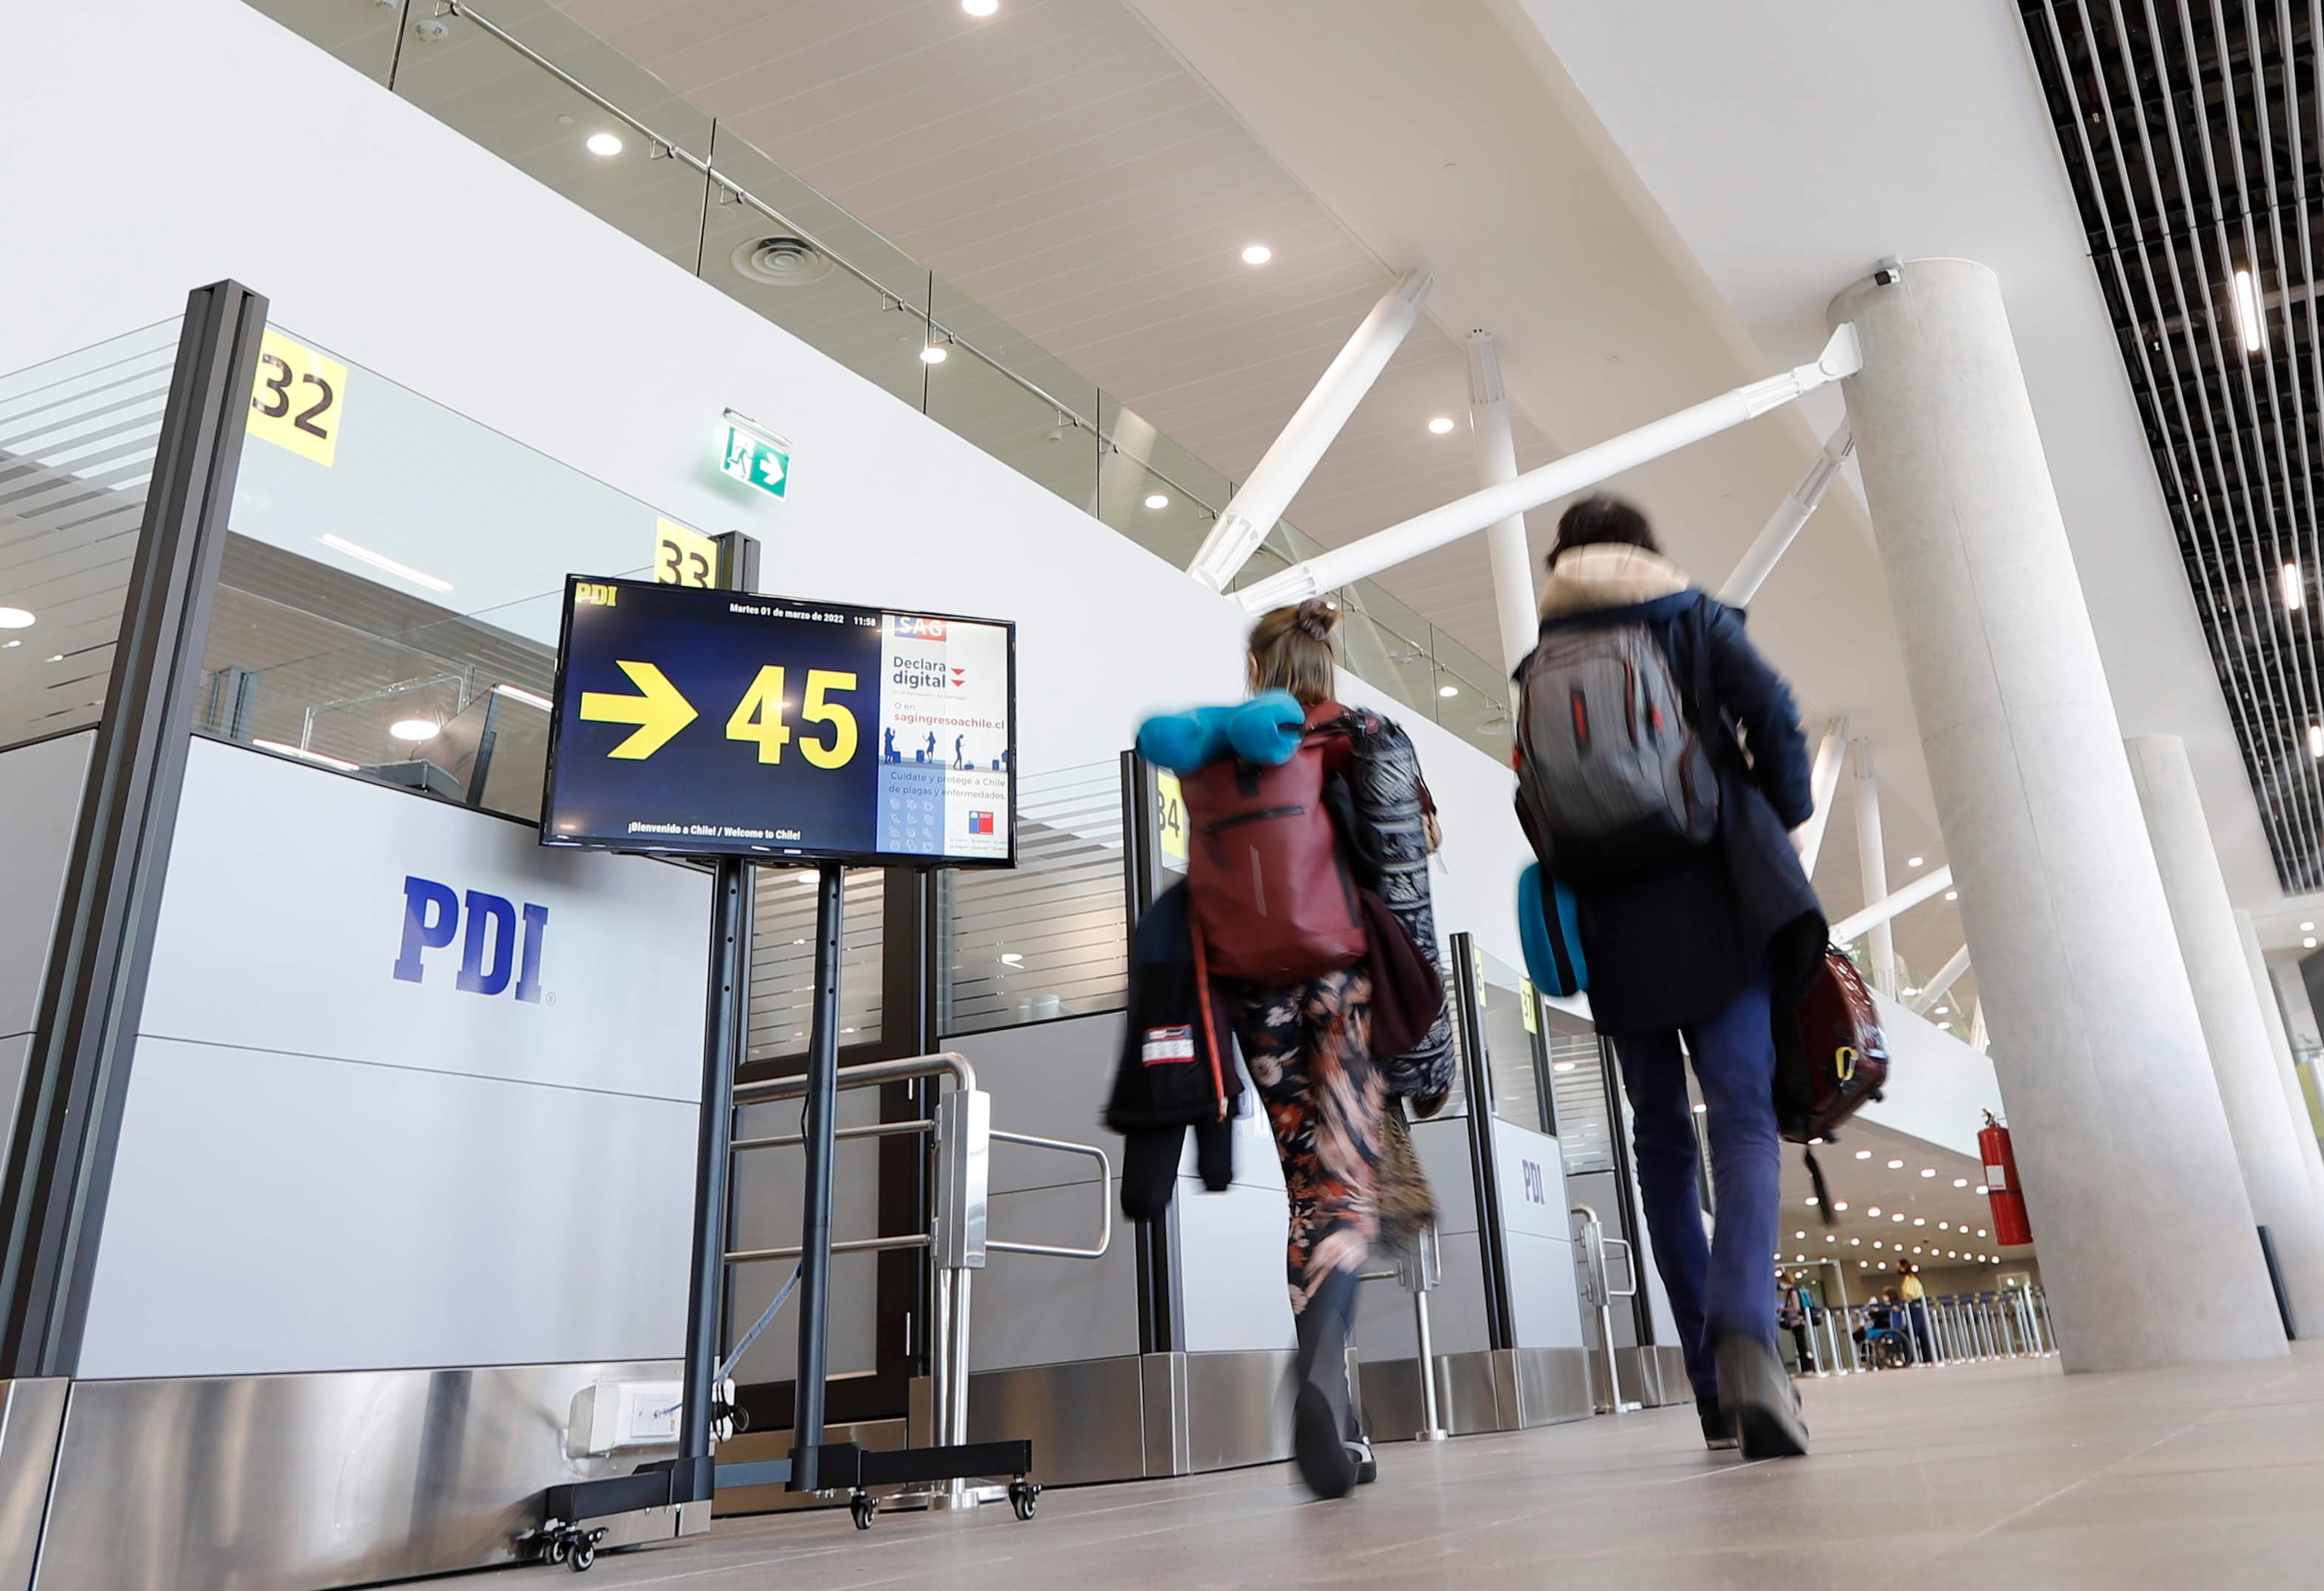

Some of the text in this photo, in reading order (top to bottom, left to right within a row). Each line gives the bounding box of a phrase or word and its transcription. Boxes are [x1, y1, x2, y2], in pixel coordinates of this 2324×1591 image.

[252, 353, 333, 440] 32
[574, 582, 617, 607] PDI
[730, 603, 844, 624] Martes 01 de marzo de 2022
[854, 616, 877, 627] 11:58
[899, 616, 943, 637] SAG
[894, 656, 946, 672] Declara
[893, 670, 945, 689] digital
[726, 665, 858, 769] 45
[894, 712, 1005, 729] sagingresoachile.cl
[889, 785, 901, 793] de
[903, 786, 932, 797] plagas
[937, 776, 972, 786] protege
[982, 779, 1005, 787] Chile
[690, 825, 716, 837] Chile!
[724, 827, 763, 839] Welcome
[765, 830, 774, 839] to
[775, 829, 801, 840] Chile!
[393, 875, 548, 1004] PDI
[1522, 990, 1533, 1020] 37
[1521, 1158, 1545, 1206] PDI
